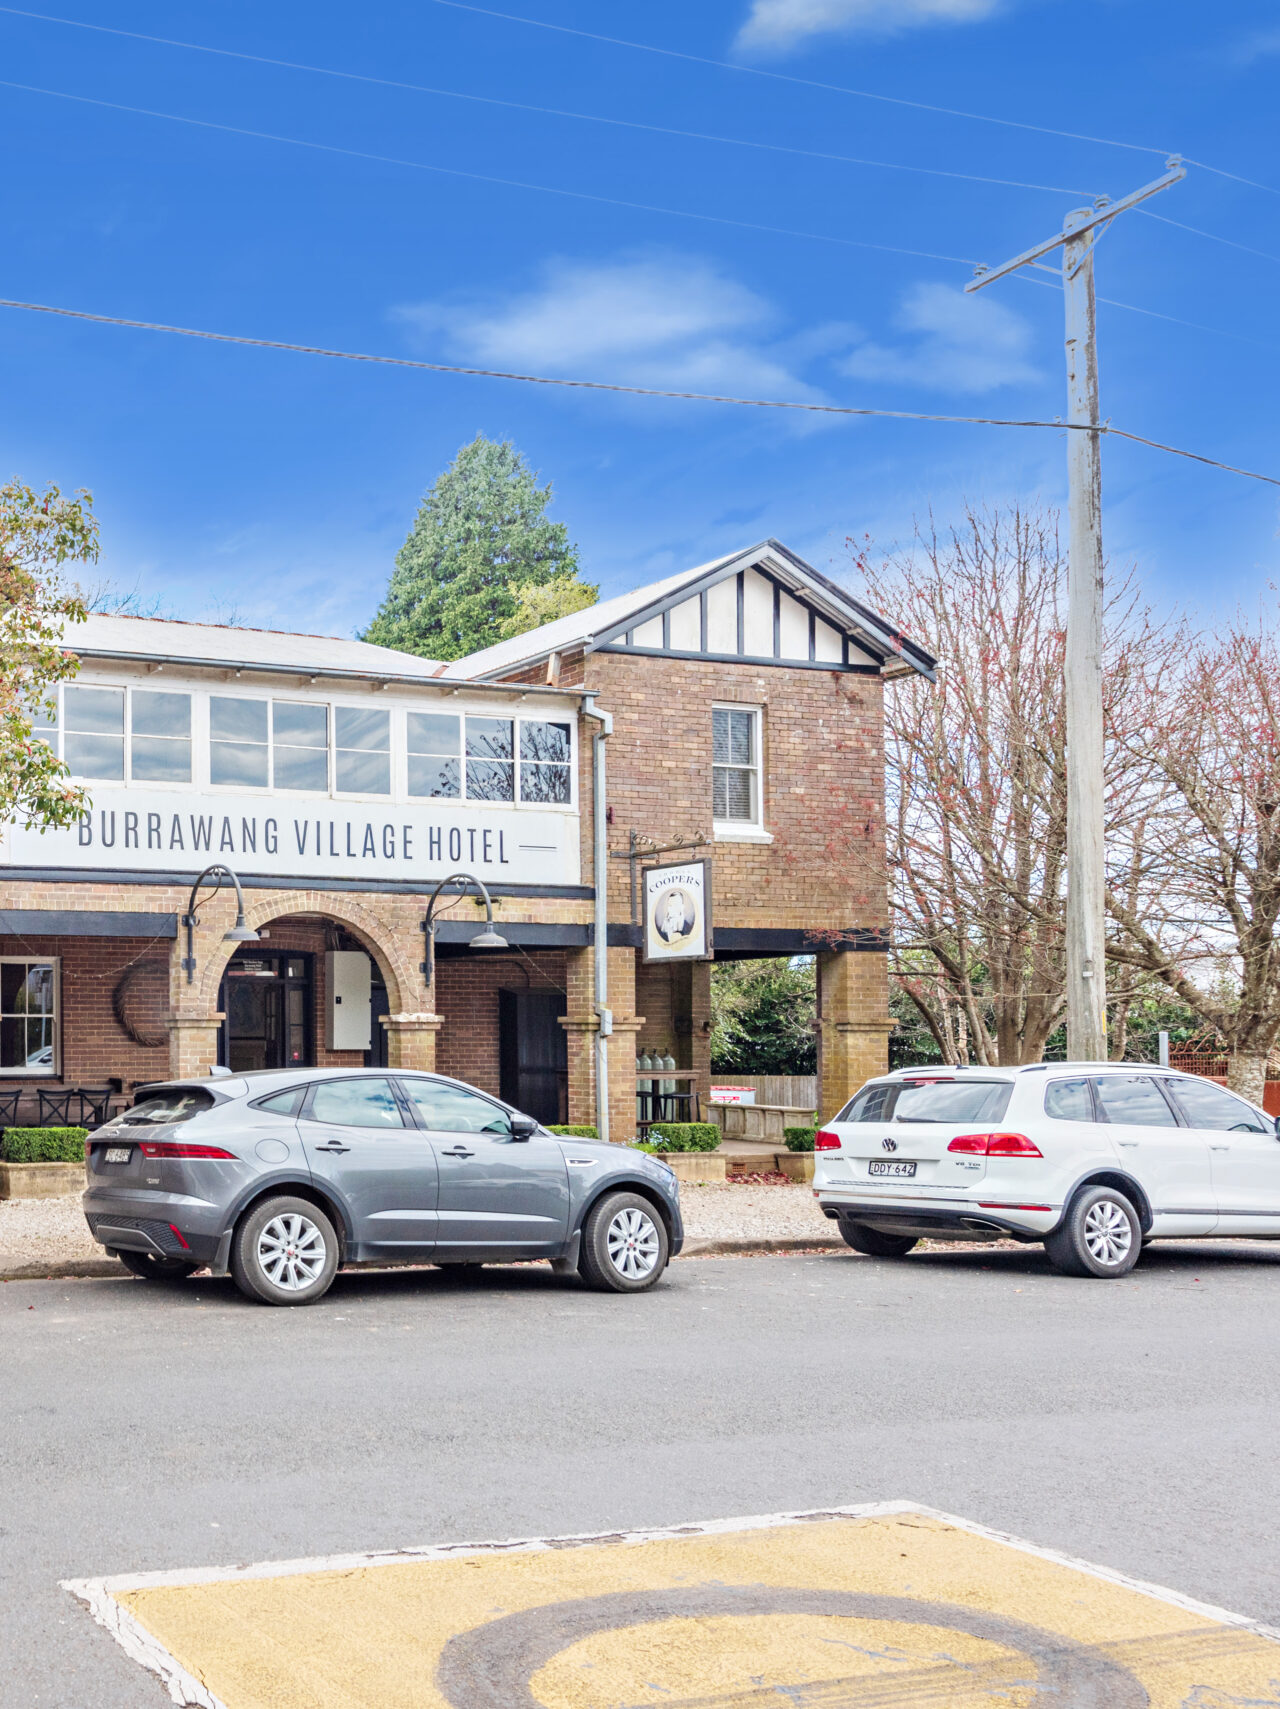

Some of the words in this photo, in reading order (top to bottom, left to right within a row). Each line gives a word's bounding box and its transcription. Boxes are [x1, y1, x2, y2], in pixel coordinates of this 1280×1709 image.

[78, 810, 278, 854] BURRAWANG
[294, 819, 413, 859] VILLAGE
[429, 826, 509, 864] HOTEL
[649, 875, 700, 893] COOPERS
